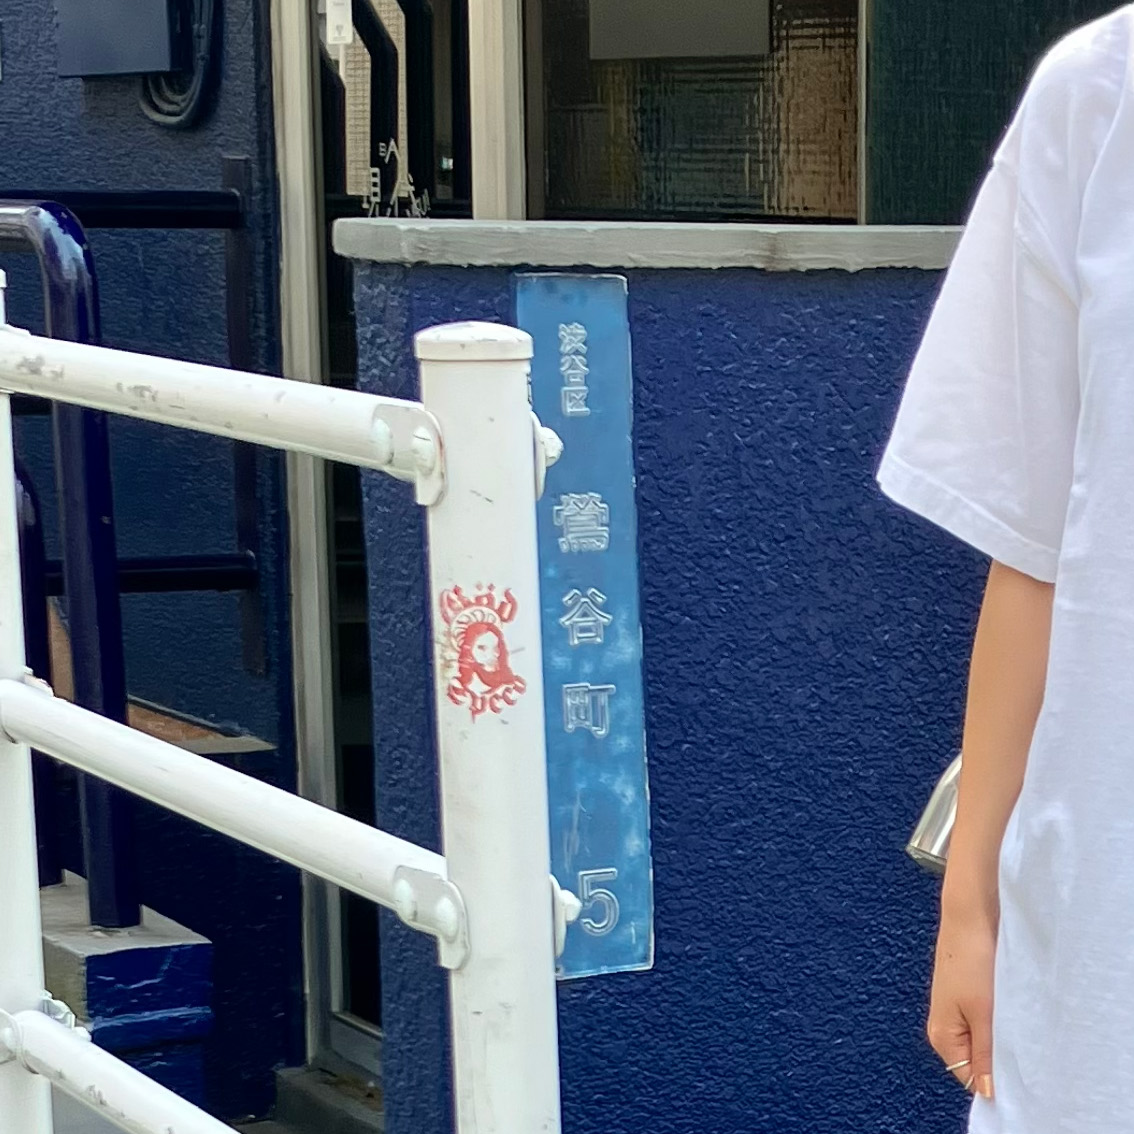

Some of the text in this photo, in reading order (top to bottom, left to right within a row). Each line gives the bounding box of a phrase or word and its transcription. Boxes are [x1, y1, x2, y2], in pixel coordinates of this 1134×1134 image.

[558, 322, 591, 417] 渋谷区
[577, 868, 620, 936] 5
